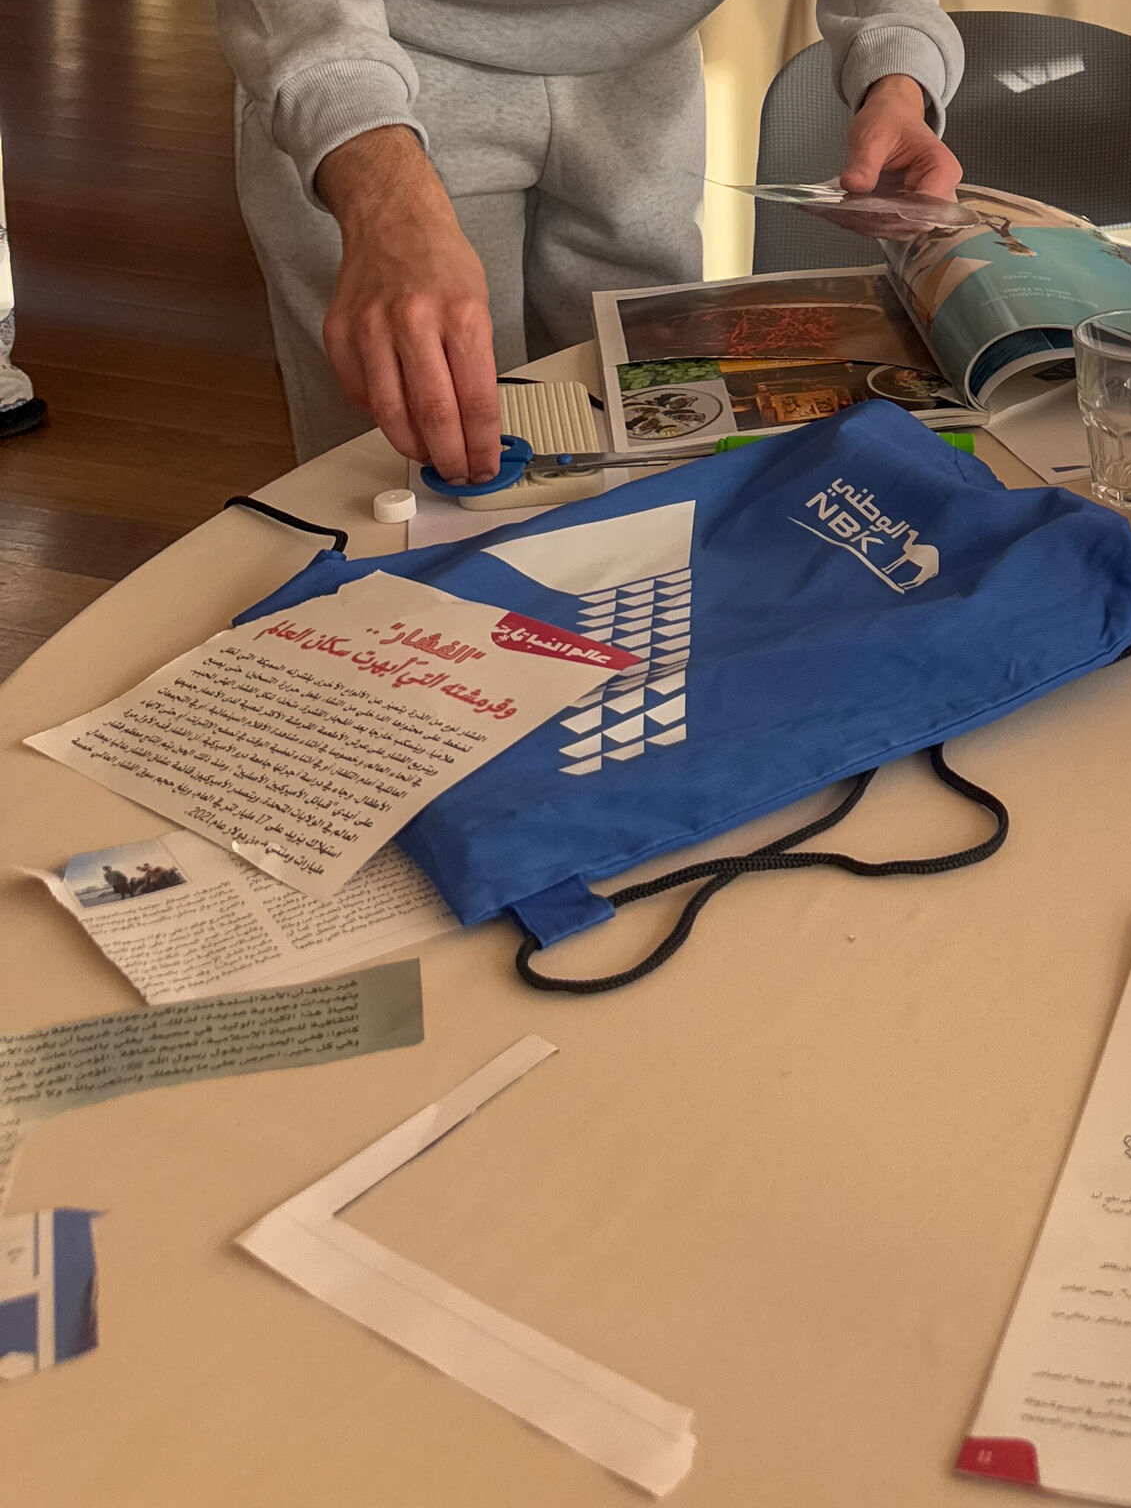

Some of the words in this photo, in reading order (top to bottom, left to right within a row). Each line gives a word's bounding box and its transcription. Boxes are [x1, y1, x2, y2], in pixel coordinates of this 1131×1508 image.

[827, 478, 911, 539] الوطني
[805, 492, 885, 554] NBK
[252, 620, 313, 650] العالم
[302, 633, 350, 658] سكان
[235, 653, 256, 661] التي
[565, 649, 612, 664] عالم
[202, 657, 227, 669] يصبح
[223, 664, 243, 673] حتى
[256, 657, 286, 671] السميكة
[351, 649, 419, 679] أبهرت
[213, 677, 237, 686] الهش
[286, 668, 315, 683] بقشرته
[391, 672, 451, 689] التي
[174, 677, 197, 691] جميعها
[231, 683, 259, 694] الفشار
[277, 680, 300, 693] حرارة
[312, 679, 345, 690] الأخرى
[157, 687, 192, 703] التجمعات
[194, 686, 226, 699] الأعمار
[255, 691, 277, 700] شكل
[300, 690, 322, 702] بفعل
[340, 688, 371, 699] الأنواع
[188, 698, 199, 708] في
[193, 702, 211, 710] أو
[220, 696, 242, 705] لدى
[239, 699, 264, 713] شعبية
[367, 696, 383, 705] عن
[440, 683, 518, 720] وقرمشته
[123, 708, 138, 719] مرة
[157, 707, 176, 716] حتى
[342, 704, 357, 712] من
[381, 701, 407, 714] يتميز
[134, 714, 157, 724] لأول
[258, 709, 286, 720] الأكثر
[323, 714, 354, 726] انفجار
[354, 709, 392, 722] الداخلي
[407, 709, 432, 721] الذرة
[102, 720, 126, 730] فشار
[242, 720, 272, 731] الأفلام
[351, 724, 369, 734] بعد
[391, 719, 424, 735] محتواها
[428, 719, 444, 727] من
[85, 729, 112, 744] بمعدل
[119, 727, 144, 738] معظم
[164, 726, 193, 737] الفشار
[211, 726, 241, 737] تصفح
[235, 731, 248, 742] في
[269, 727, 300, 742] مشاهدة
[316, 725, 350, 741] الأطعمة
[421, 733, 441, 742] على
[456, 730, 487, 742] الفشار
[71, 737, 94, 752] خمسة
[157, 740, 175, 751] يتم
[201, 736, 237, 753] الأميركية
[245, 736, 271, 748] الوقت
[297, 739, 324, 748] أثناء
[317, 743, 329, 753] في
[344, 738, 369, 750] عرش
[442, 738, 473, 753] تضغط
[123, 746, 153, 758] الفشار
[170, 745, 196, 756] الحين
[268, 743, 297, 757] تمضية
[366, 747, 386, 755] على
[90, 751, 118, 762] العالمي
[146, 753, 171, 766] عشاق
[193, 752, 212, 763] ذلك
[248, 753, 271, 769] جامعة
[291, 753, 319, 764] أثناء
[381, 752, 413, 763] الفشار
[111, 760, 141, 771] الفشار
[170, 760, 196, 775] قائمة
[209, 757, 229, 771] ومنذ
[311, 758, 324, 769] في
[318, 762, 337, 772] أو
[406, 762, 438, 776] ويتربع
[135, 767, 155, 779] سوق
[272, 762, 304, 778] أجرتها
[152, 776, 175, 787] حجم
[189, 771, 233, 789] الأميركيون
[299, 772, 324, 787] دراسة
[354, 777, 380, 786] أمام
[388, 771, 417, 782] أنحاء
[410, 776, 423, 788] في
[265, 780, 308, 799] الأميركيين
[321, 780, 333, 792] في
[375, 781, 408, 798] العائلية
[226, 787, 261, 803] ويتصدر
[331, 787, 354, 800] وجاء
[211, 796, 224, 809] في
[218, 802, 239, 812] لتر
[231, 808, 256, 820] مليار
[254, 813, 273, 825] 17
[289, 808, 325, 827] الولايات
[331, 808, 361, 822] أيدي
[207, 819, 226, 830] عام
[264, 823, 284, 834] على
[321, 821, 333, 834] في
[353, 817, 373, 828] على
[221, 826, 248, 844] دولار
[284, 830, 306, 846] يزيد
[329, 829, 359, 842] العالم
[305, 838, 342, 858] استهلاك
[293, 855, 324, 875] مليارات
